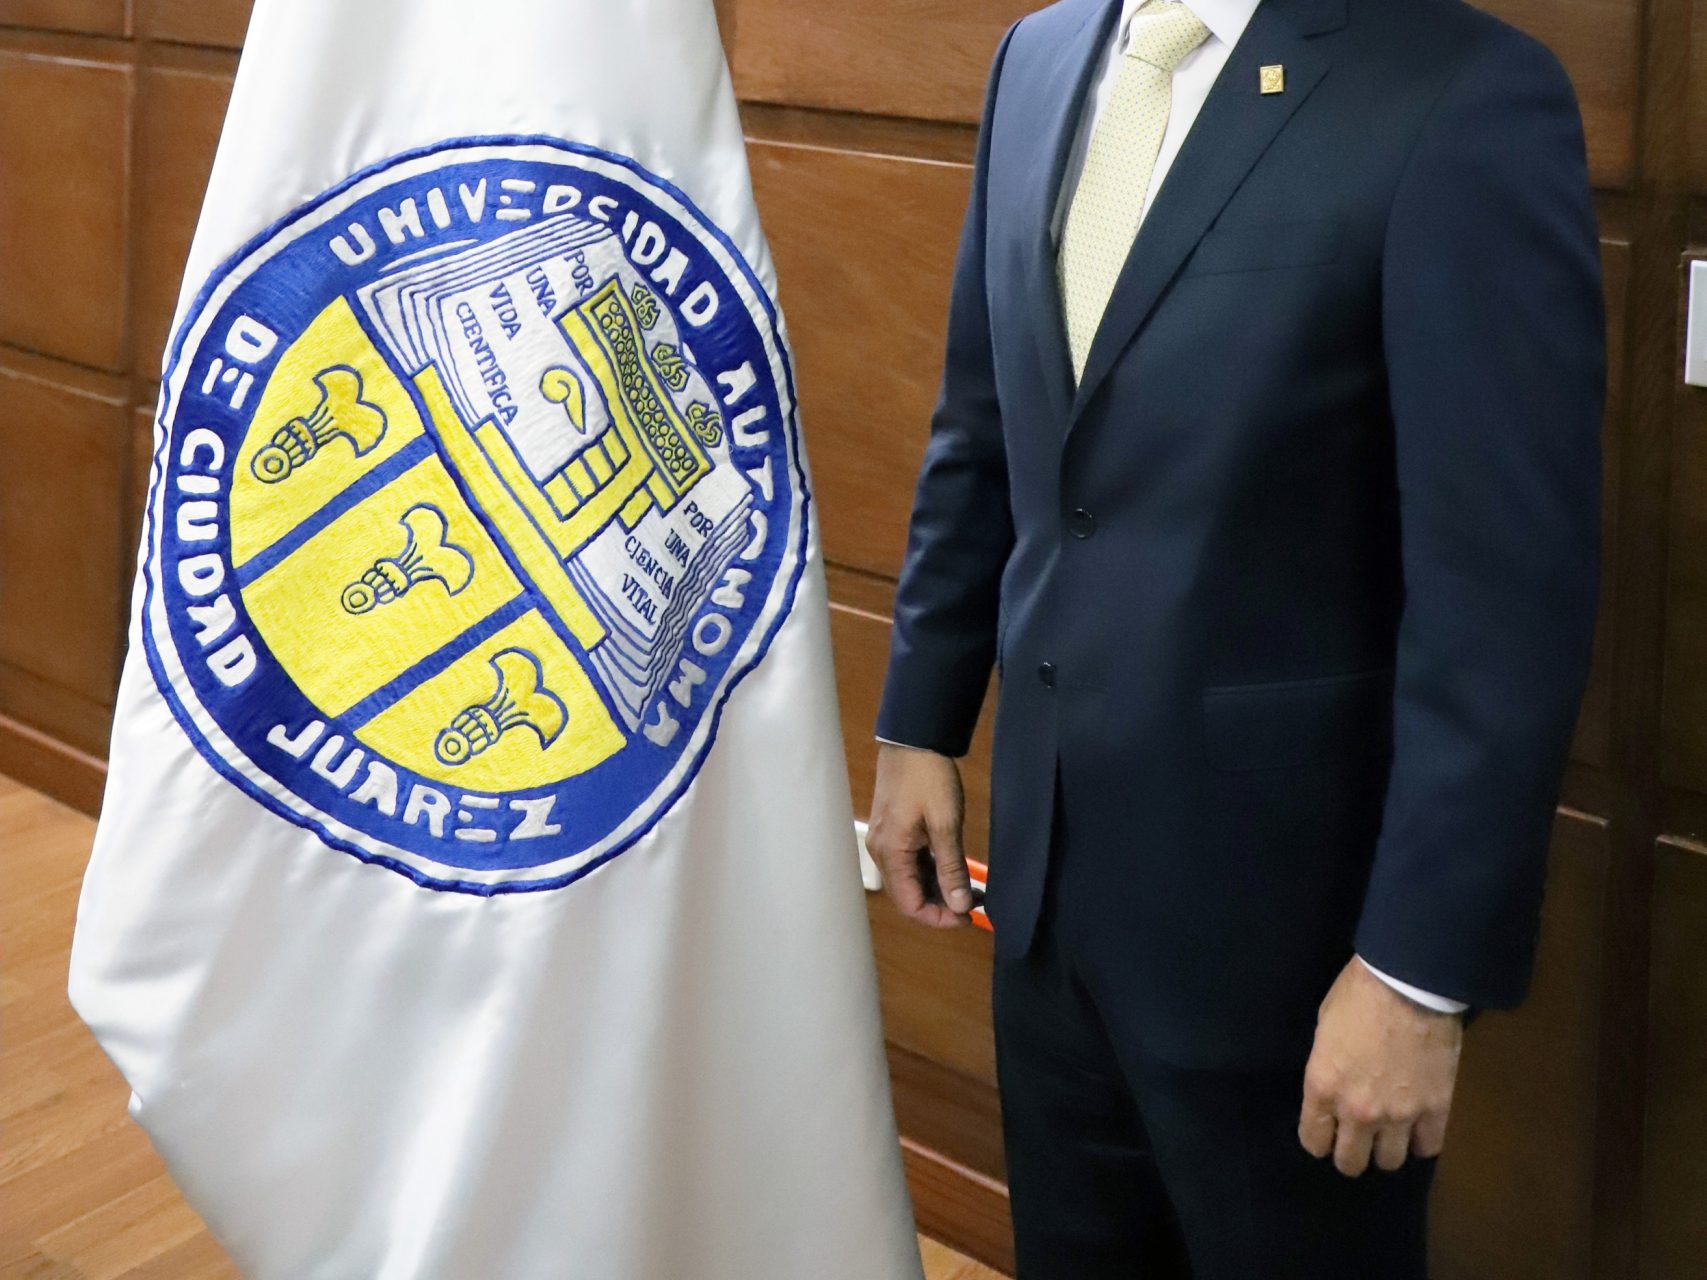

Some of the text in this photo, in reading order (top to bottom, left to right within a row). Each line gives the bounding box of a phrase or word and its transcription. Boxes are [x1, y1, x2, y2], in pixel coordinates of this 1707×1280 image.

[525, 265, 556, 318] UNA
[564, 250, 596, 296] POR
[487, 282, 522, 341] VIDA
[202, 314, 278, 410] DE
[456, 301, 519, 426] CIENTIFICA
[664, 528, 691, 568] UNA
[683, 501, 715, 538] POR
[176, 428, 258, 688] CIUDAD
[625, 535, 674, 600] CIENCIA
[622, 572, 658, 625] VITAL
[267, 720, 562, 842] JUAREZ
